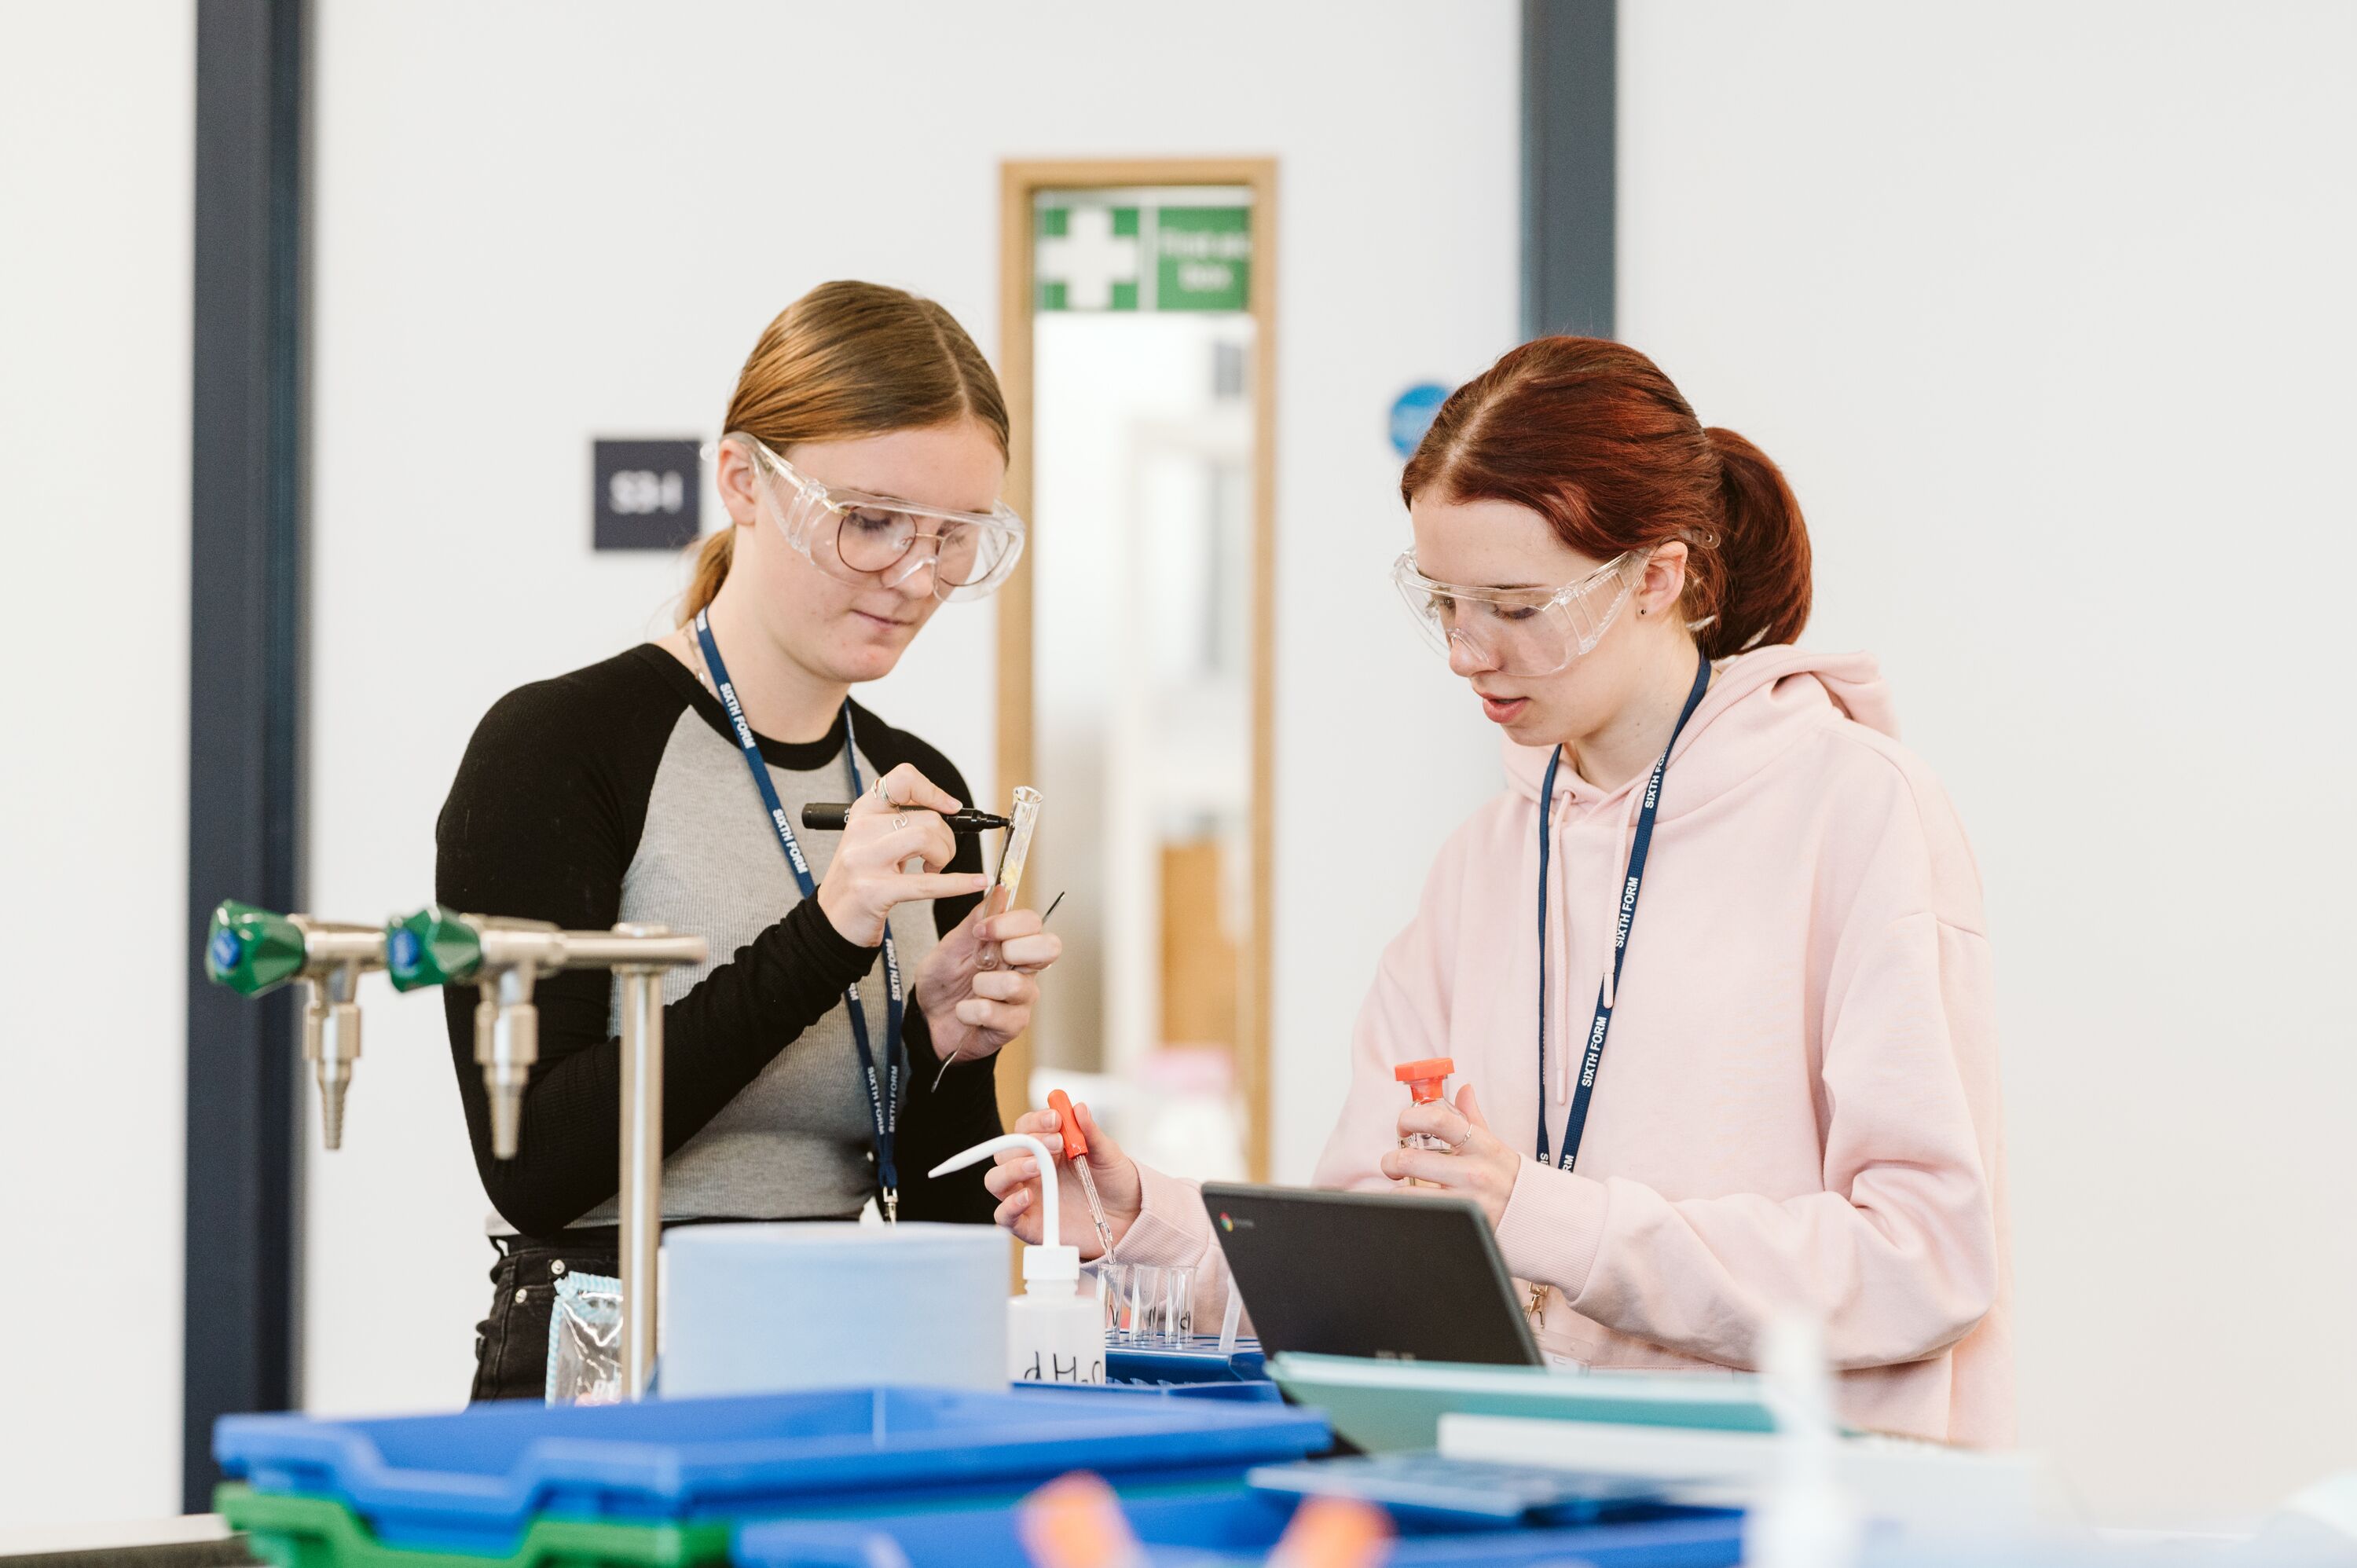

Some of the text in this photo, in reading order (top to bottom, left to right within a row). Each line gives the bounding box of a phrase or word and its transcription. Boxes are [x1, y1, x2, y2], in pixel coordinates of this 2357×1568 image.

[720, 683, 756, 749] SIXTH FORM
[1644, 775, 1659, 808] SIXTH
[773, 808, 808, 874] SIXTH FORM
[1616, 877, 1638, 948] SIXTH FORM
[885, 938, 902, 1001] SIXTH FORM
[1582, 1016, 1607, 1087] SIXTH FORM
[867, 1066, 885, 1135] SIXTH FORM
